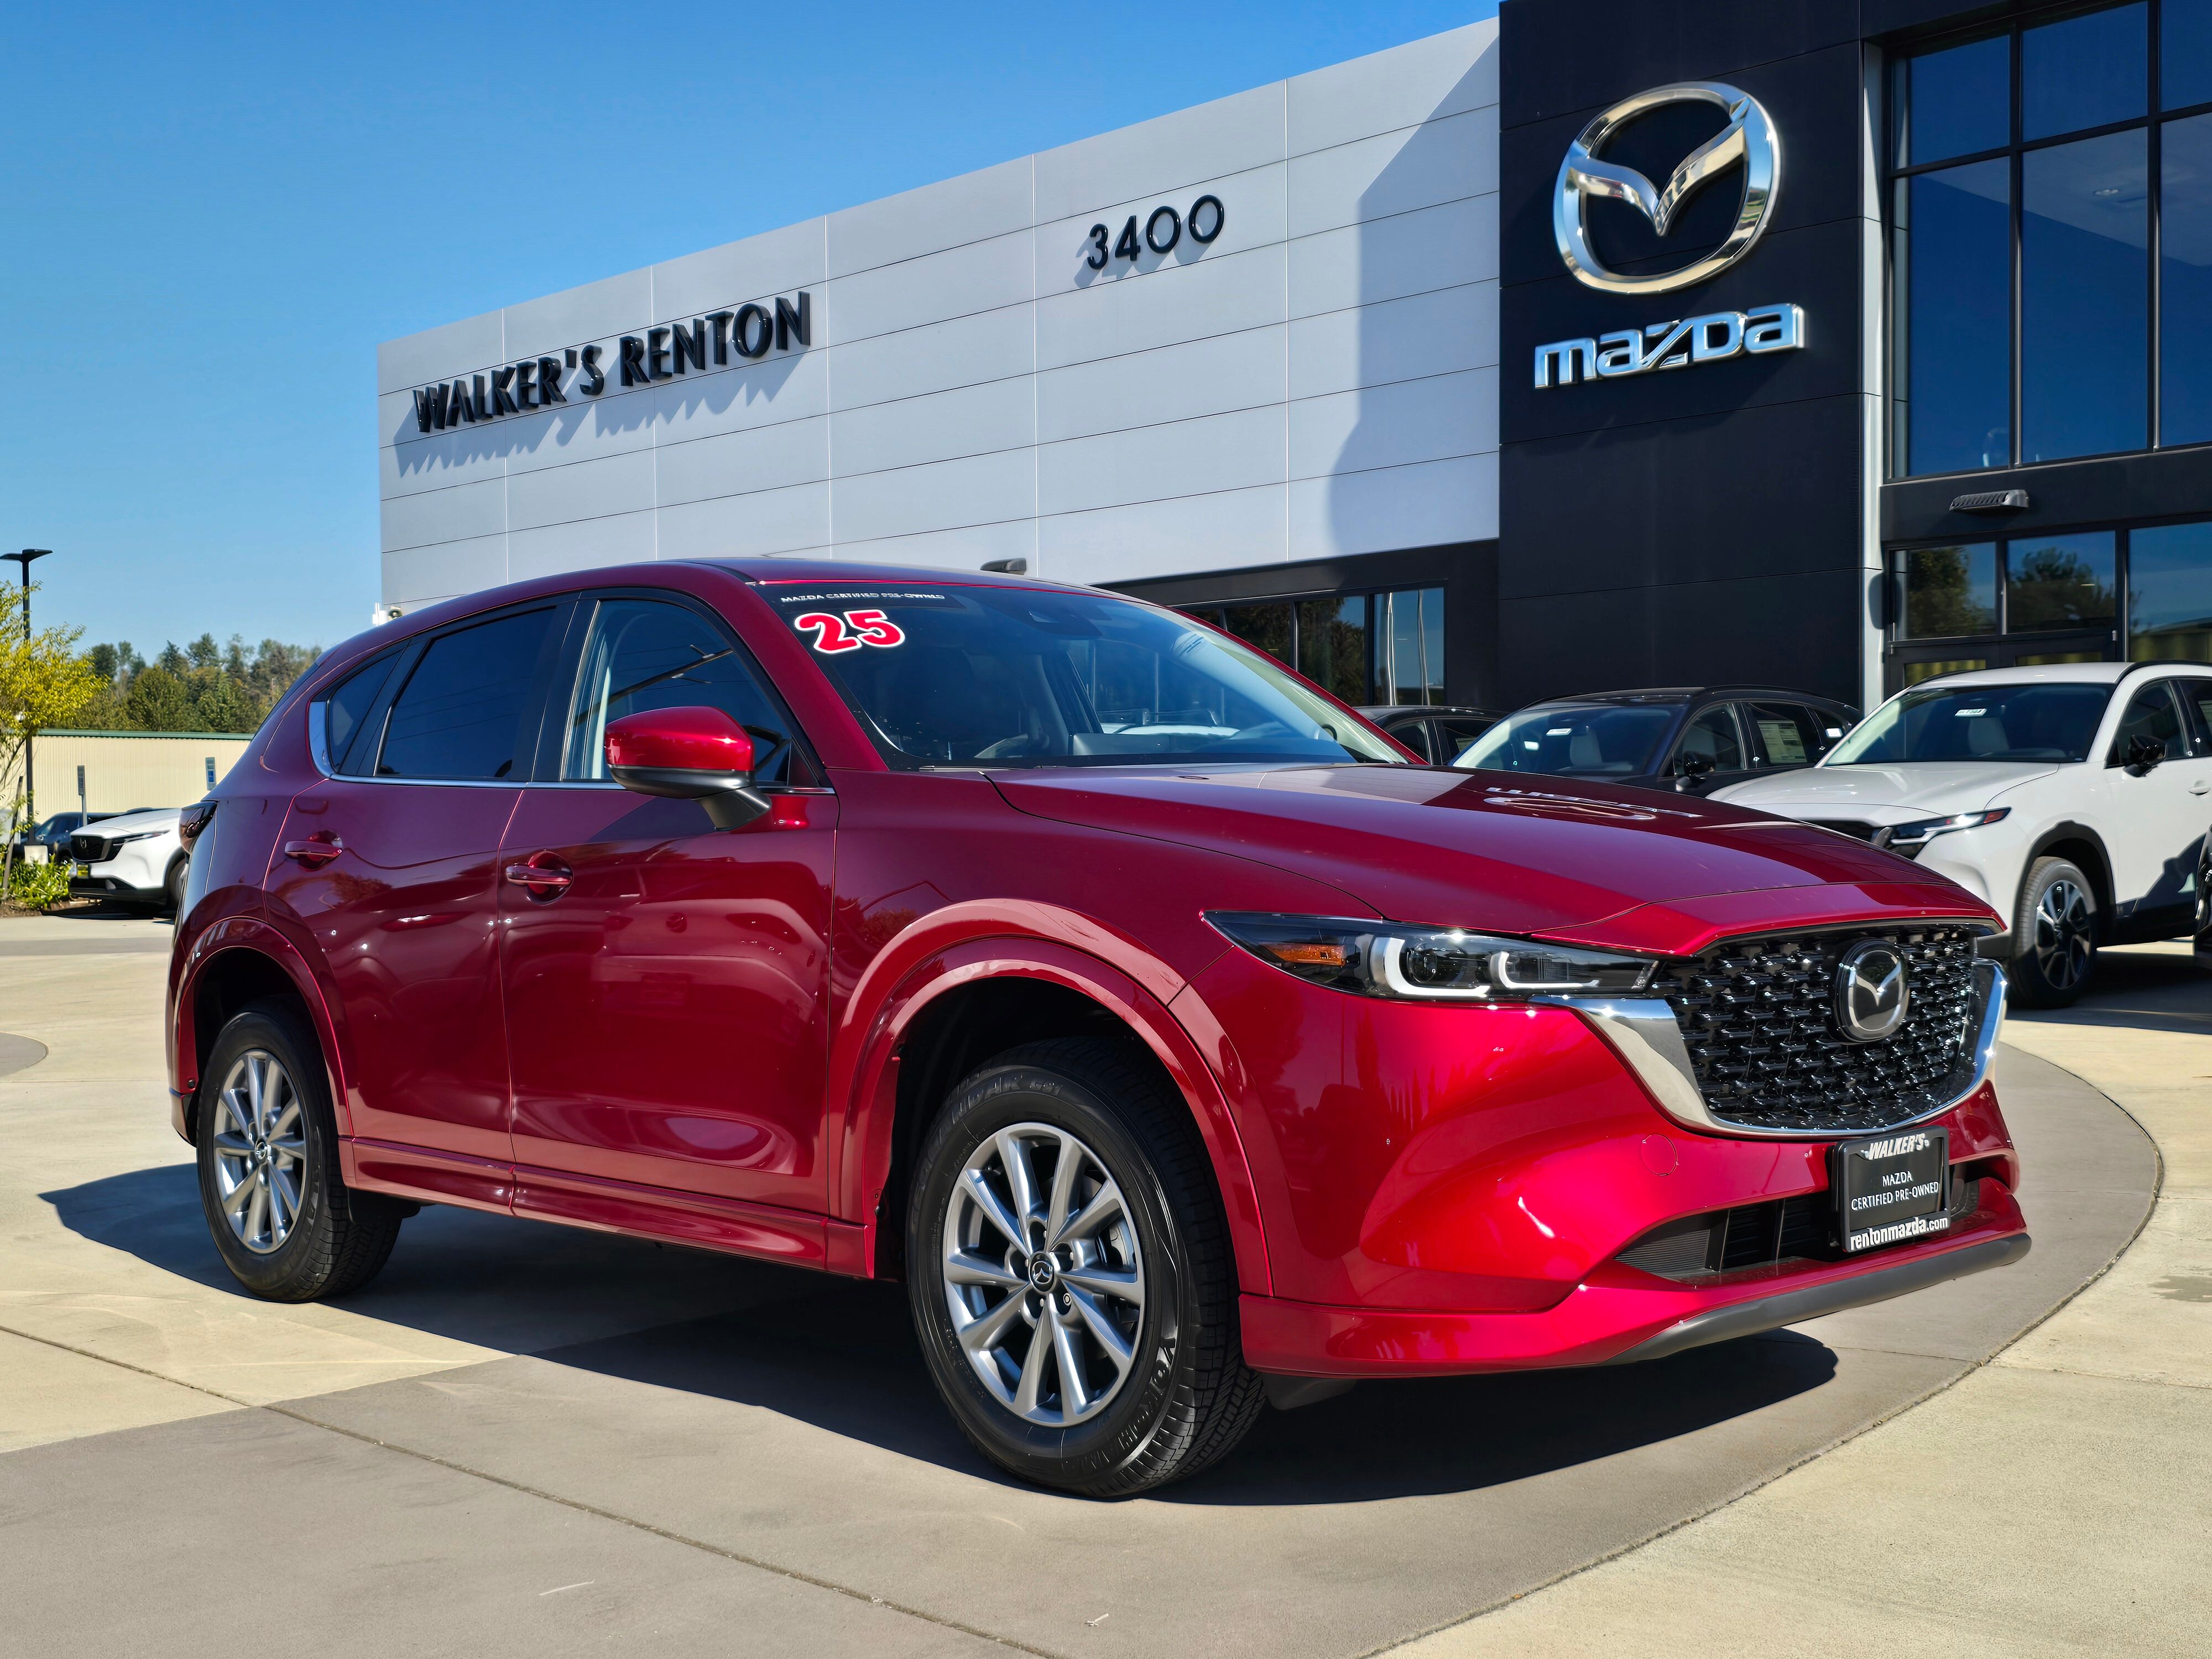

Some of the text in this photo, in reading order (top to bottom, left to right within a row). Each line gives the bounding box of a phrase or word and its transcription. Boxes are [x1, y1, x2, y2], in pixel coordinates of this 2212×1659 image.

[1087, 195, 1224, 270] 3400
[413, 291, 810, 432] WALKER'S RENTON
[794, 609, 905, 654] 25
[1868, 1133, 1925, 1160] WALKER'S
[1882, 1171, 1913, 1187] MAZDA
[1851, 1181, 1939, 1211] CERTIFIED PRE-OWNED
[1850, 1217, 1948, 1250] rentonmazda.com
